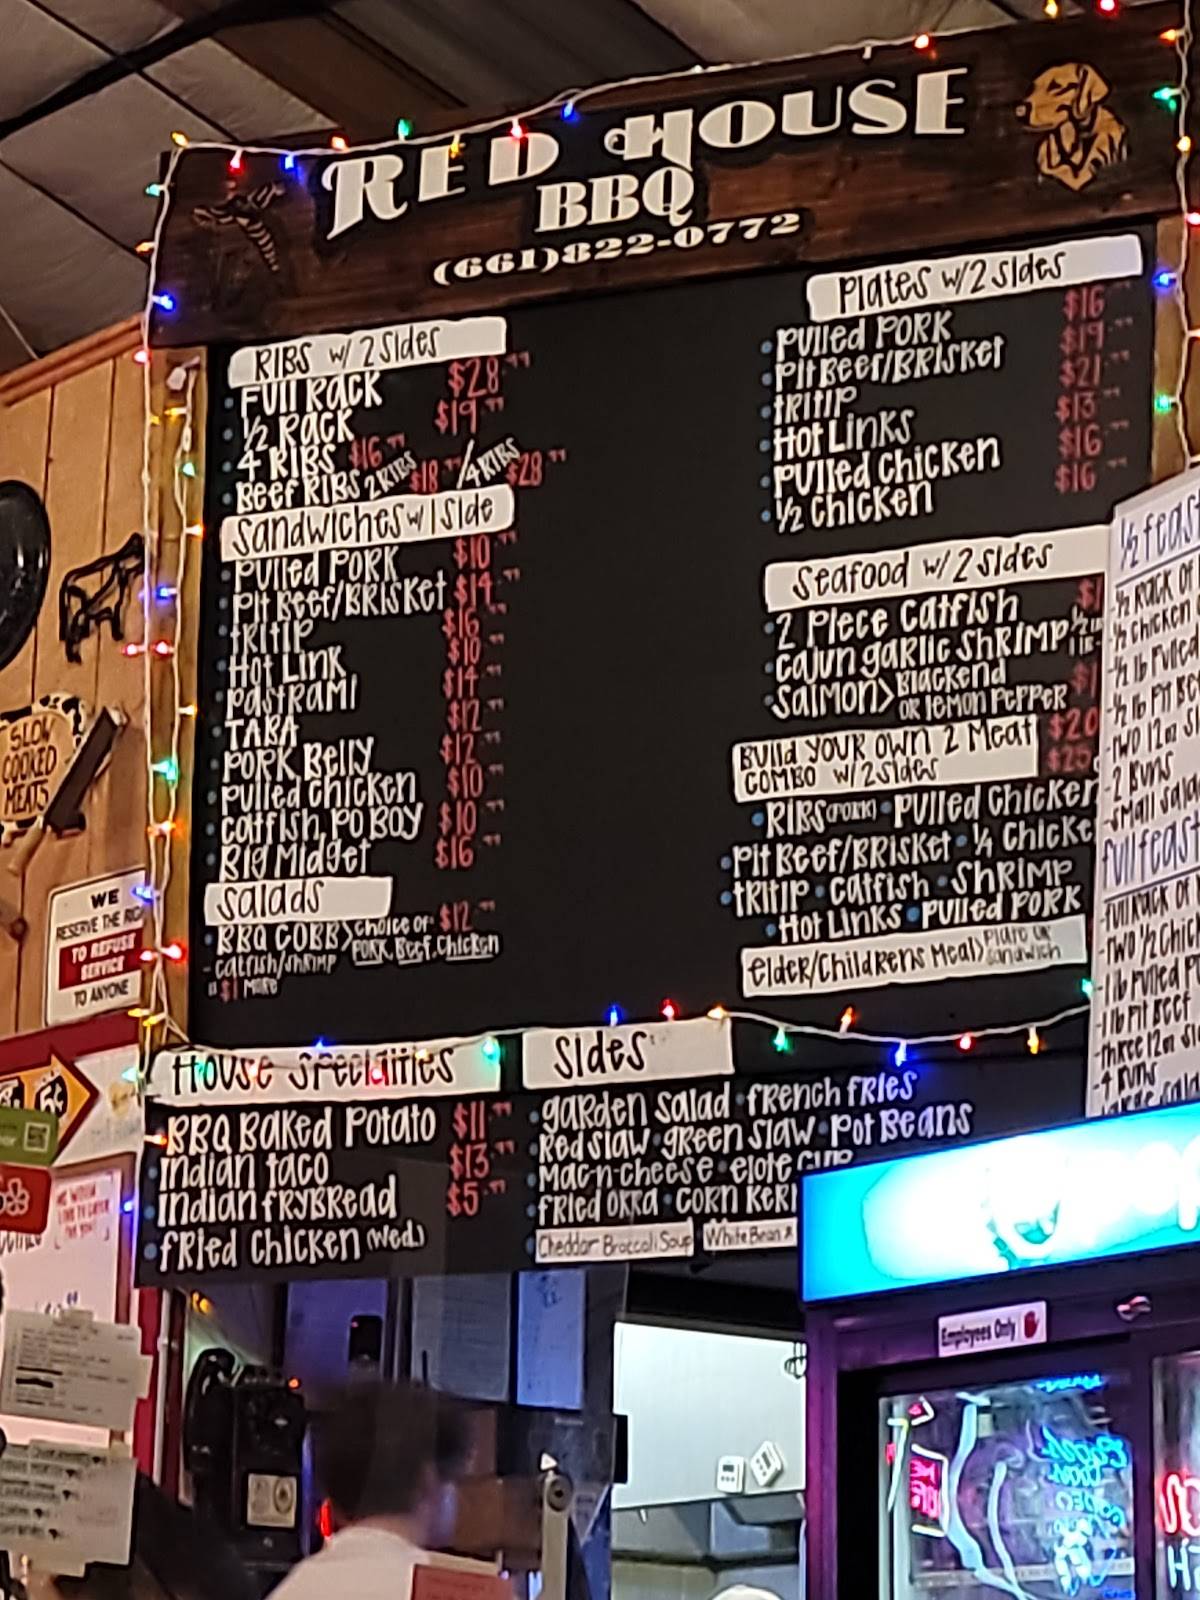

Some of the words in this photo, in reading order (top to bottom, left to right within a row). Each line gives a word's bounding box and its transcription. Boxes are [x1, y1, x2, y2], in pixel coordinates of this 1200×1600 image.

[321, 133, 560, 240] RED
[604, 68, 968, 172] HOUSE
[534, 166, 695, 232] BBQ
[433, 212, 800, 286] (661)822-0772
[839, 264, 931, 313] Plates
[776, 319, 865, 362] Pulled
[875, 310, 954, 349] PORK
[773, 421, 824, 461] Hot
[773, 451, 871, 498] Pulled
[878, 437, 1000, 485] Chicken
[809, 481, 934, 528] Chicken
[232, 500, 403, 555] Sandwiches
[234, 550, 320, 592] Pulled
[793, 551, 910, 600] Seafood
[807, 607, 888, 648] Piece
[228, 655, 273, 687] Hot
[775, 646, 857, 686] Cajun
[967, 721, 1035, 751] Meat
[222, 749, 299, 782] PORK
[303, 737, 374, 781] Belly
[221, 776, 301, 816] Pulled
[308, 772, 416, 809] Chicken
[893, 785, 981, 828] Pulled
[90, 888, 119, 910] WE
[217, 880, 324, 922] Salads
[554, 1030, 648, 1080] Sides
[655, 1082, 730, 1125] salad
[167, 1114, 233, 1156] BBQ
[345, 1103, 437, 1148] Potato
[159, 1153, 256, 1189] Indian
[266, 1153, 330, 1189] taco
[157, 1190, 257, 1228] Indian
[675, 1186, 738, 1215] corn
[251, 1224, 362, 1265] Chicken
